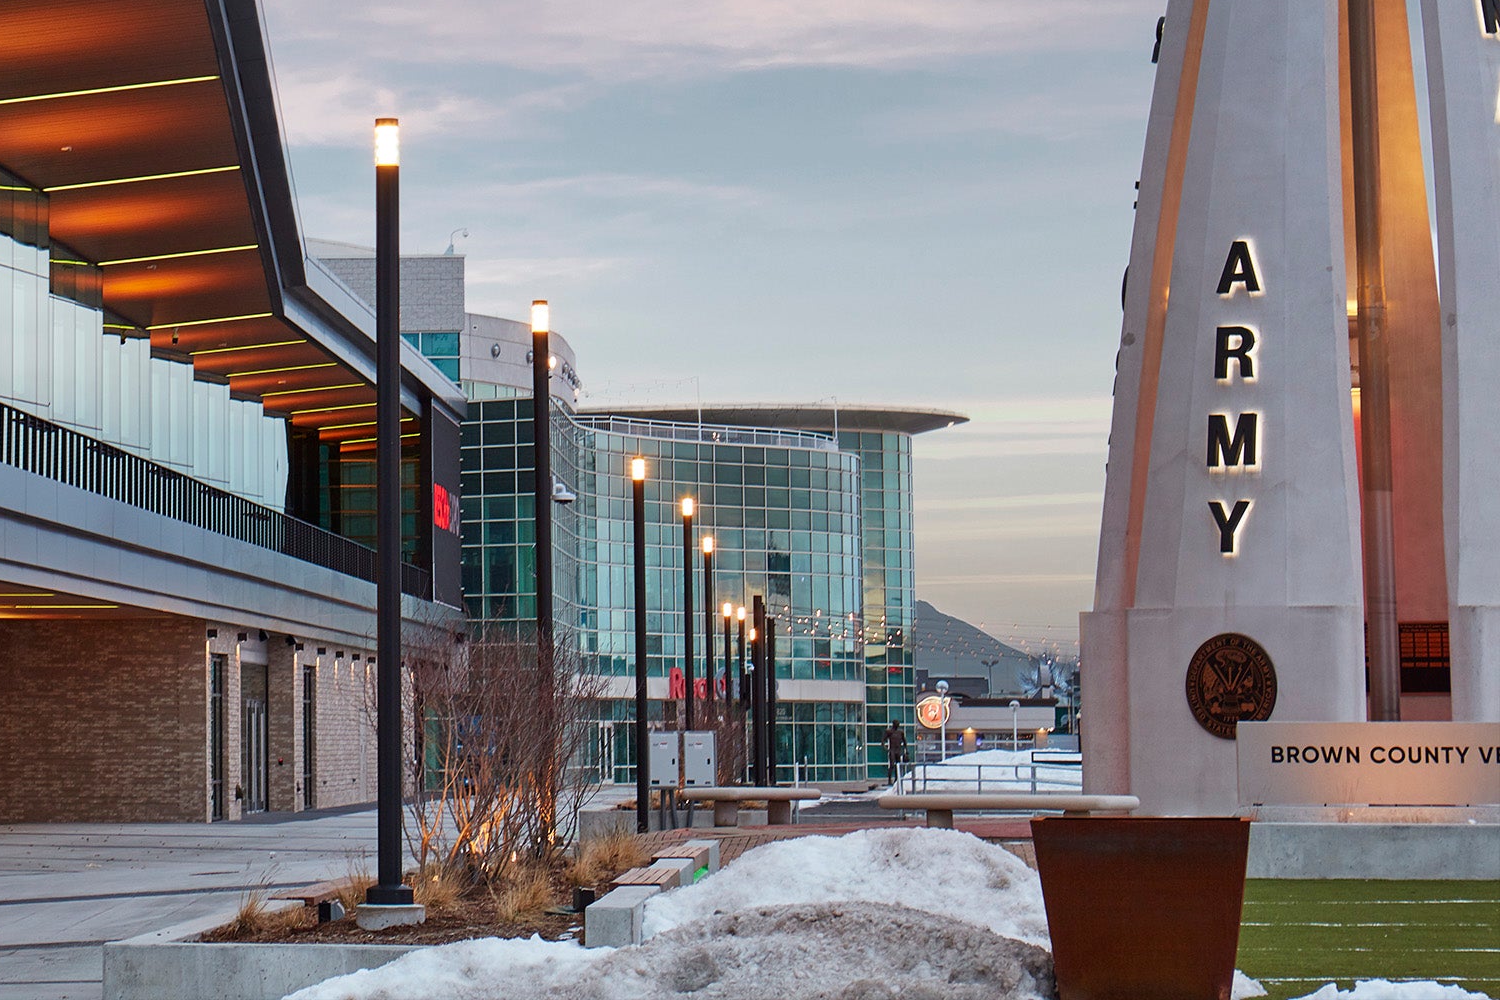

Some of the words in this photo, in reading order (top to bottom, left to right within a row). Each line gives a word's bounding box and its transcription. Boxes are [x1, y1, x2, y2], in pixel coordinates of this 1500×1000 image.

[1206, 240, 1261, 553] ARMY
[1271, 746, 1361, 764] BROWN
[1369, 746, 1470, 764] COUNTY
